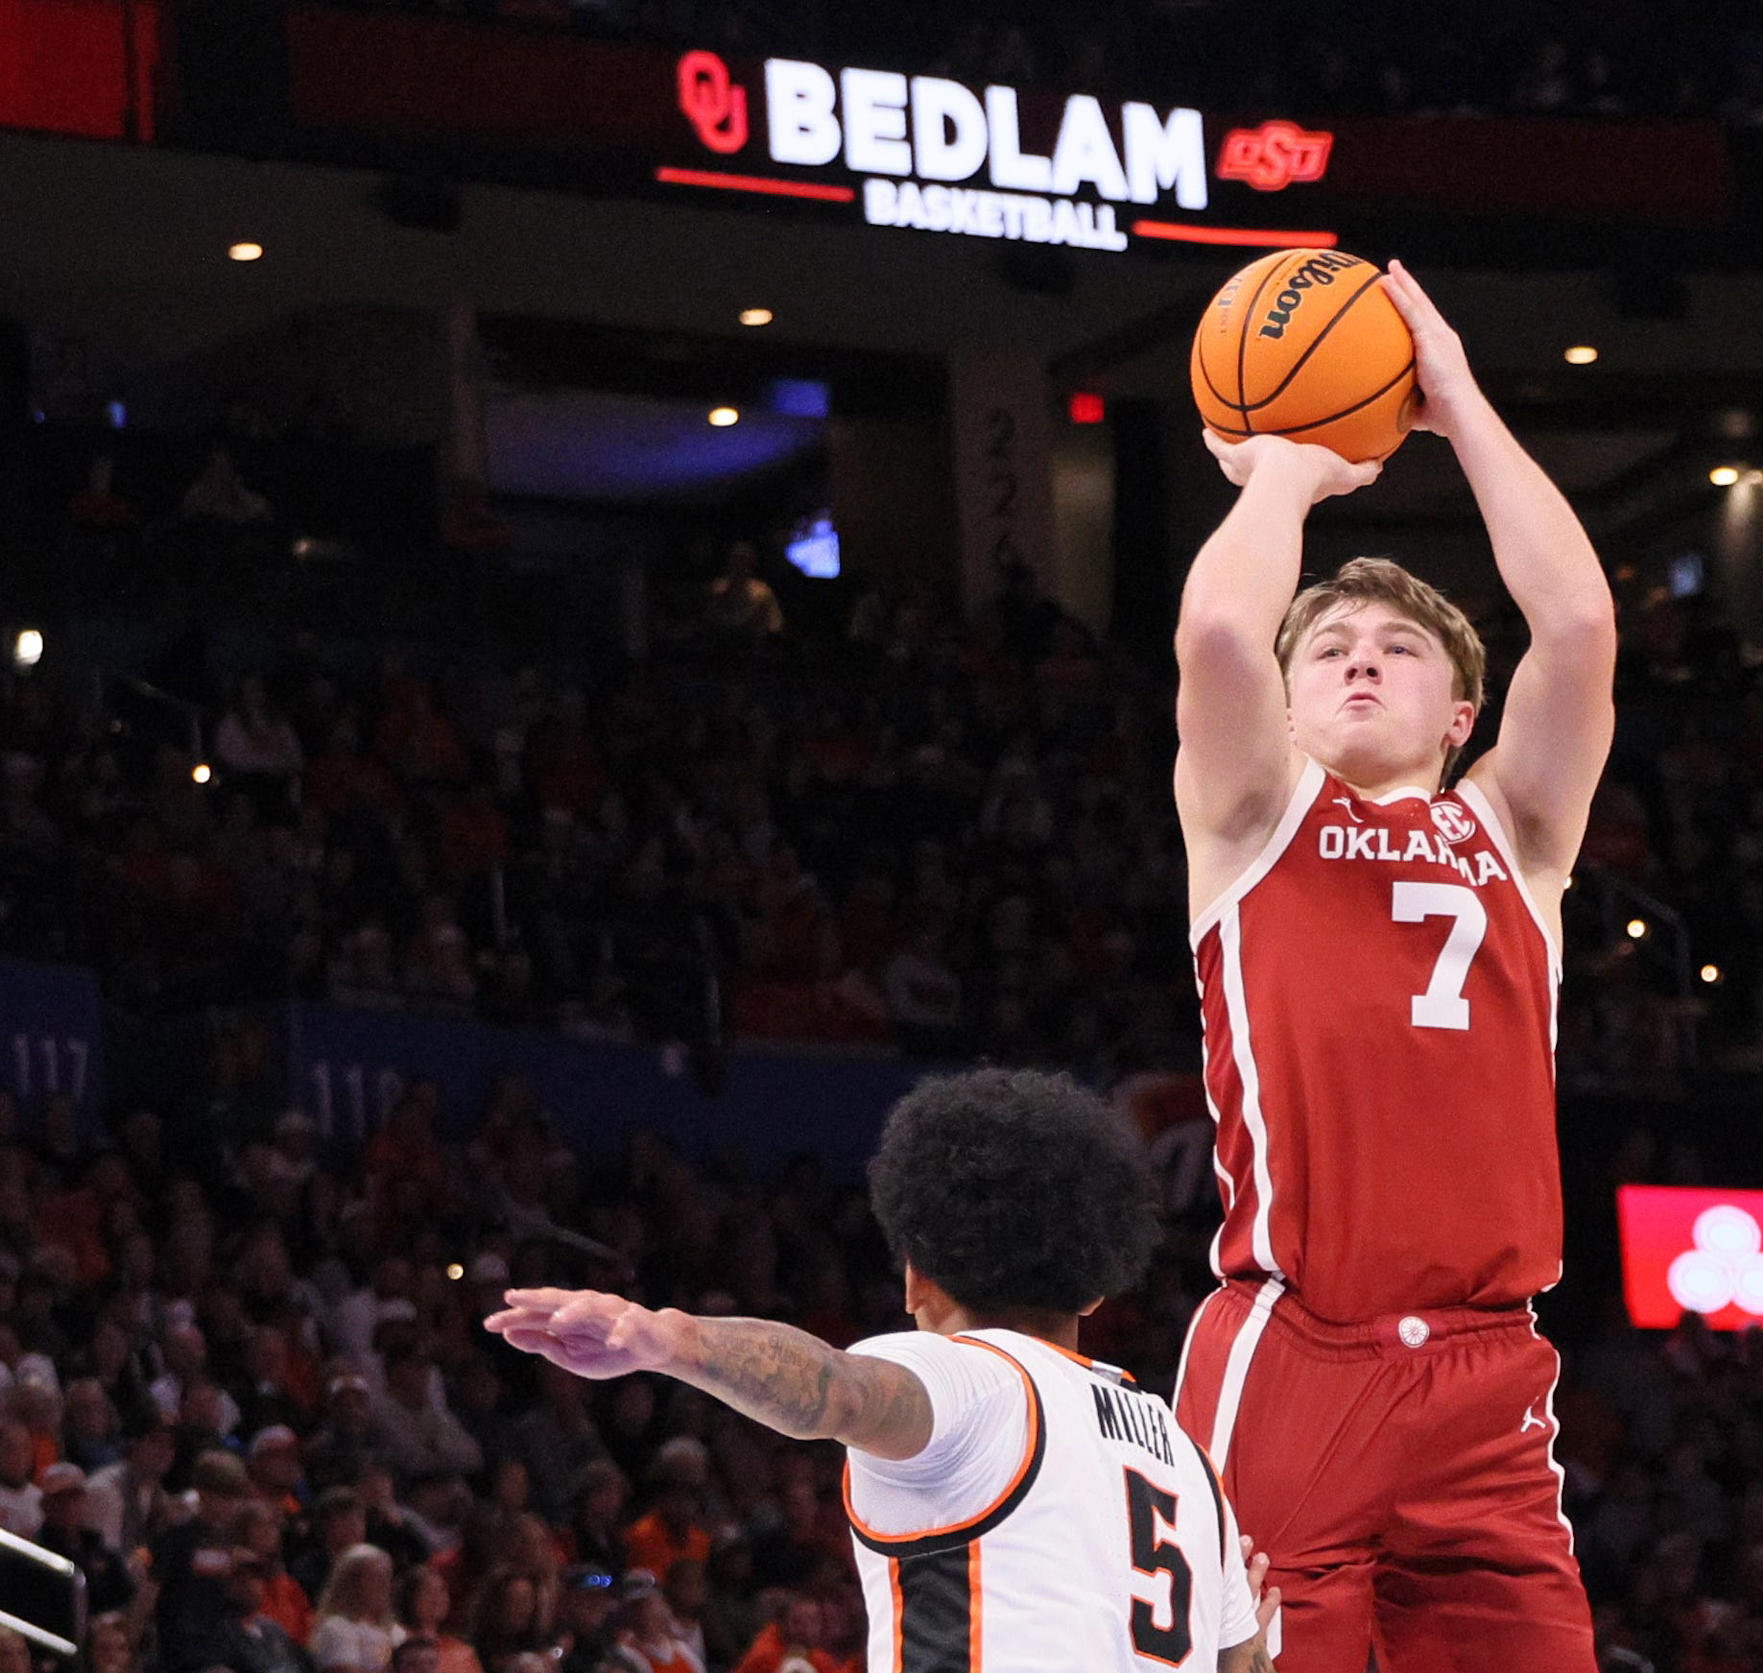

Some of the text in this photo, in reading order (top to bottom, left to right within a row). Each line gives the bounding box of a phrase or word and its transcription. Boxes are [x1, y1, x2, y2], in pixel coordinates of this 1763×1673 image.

[764, 57, 1208, 211] BEDLAM
[862, 177, 1128, 252] BASKETBALL
[1430, 804, 1473, 842] EC
[1392, 880, 1488, 1032] 7
[12, 1032, 89, 1102] 117
[1090, 1382, 1175, 1467] MILLER
[1122, 1464, 1194, 1668] 5
